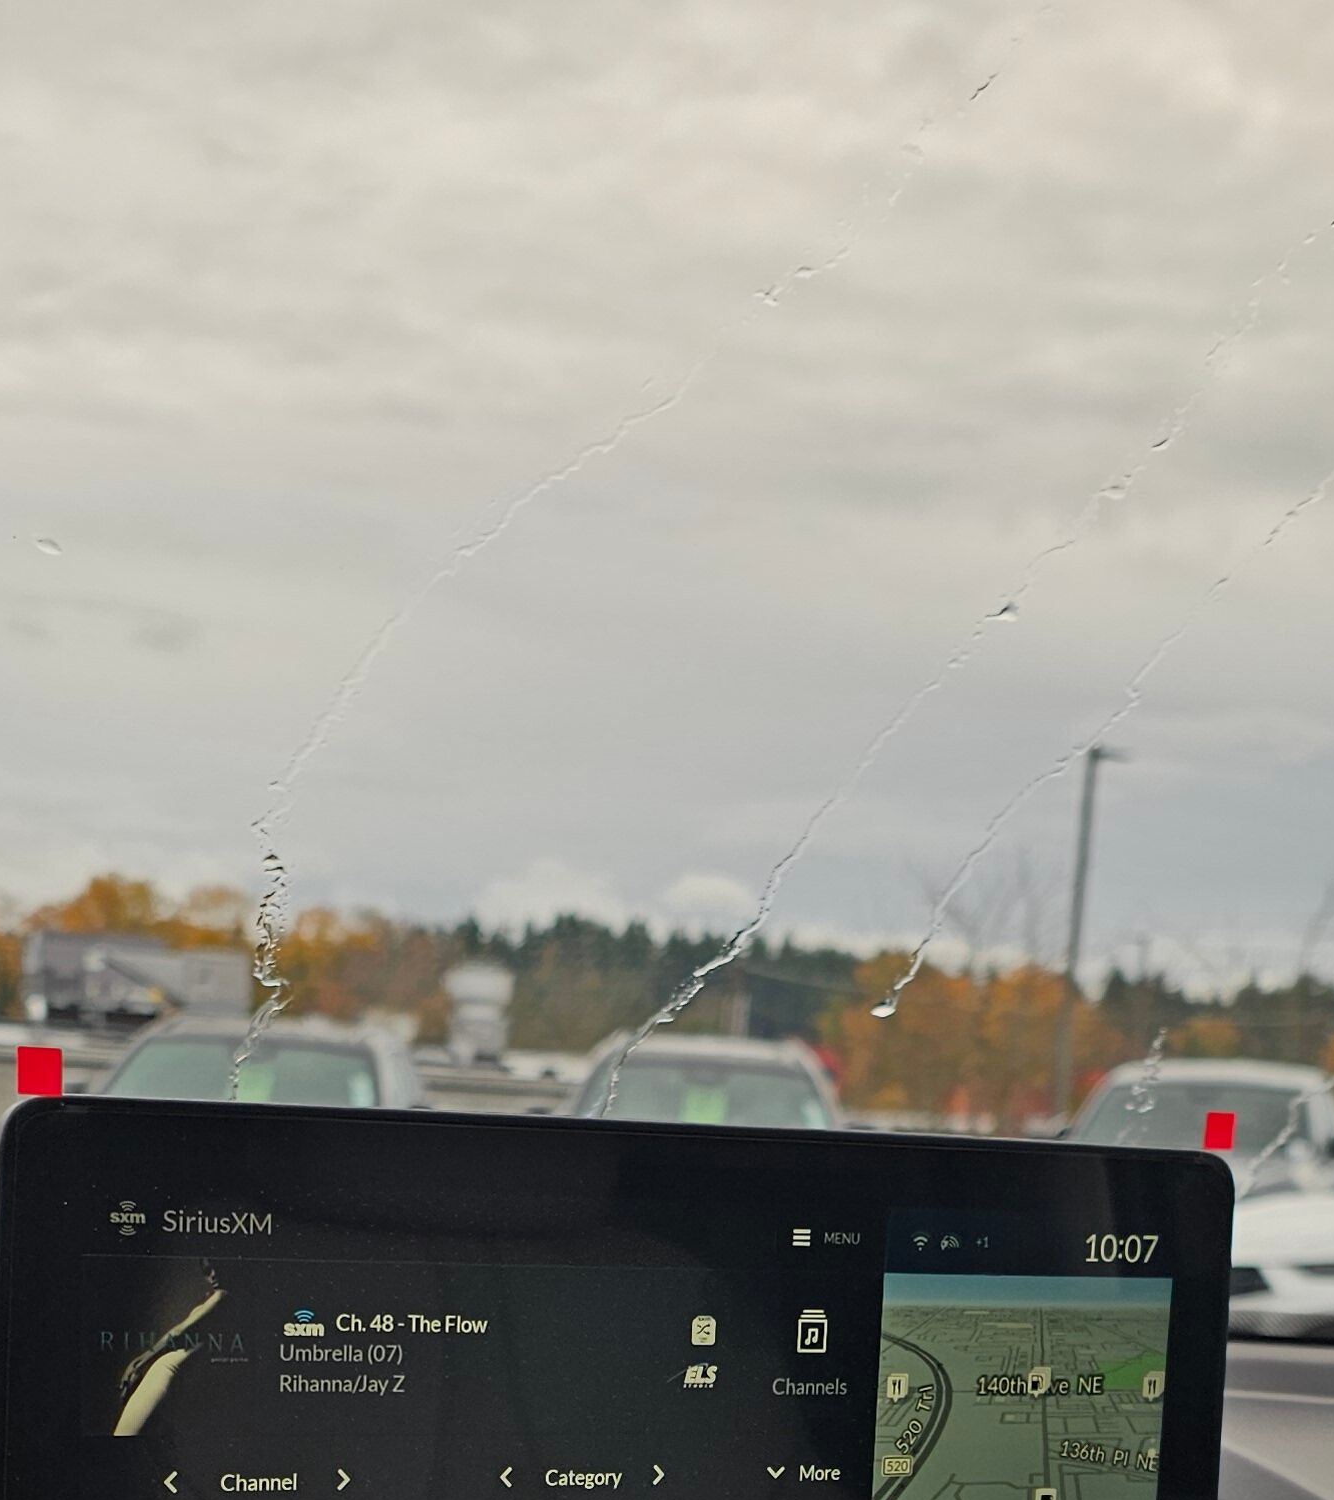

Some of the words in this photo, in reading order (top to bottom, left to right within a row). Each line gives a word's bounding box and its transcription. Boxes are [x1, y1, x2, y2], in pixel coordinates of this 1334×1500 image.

[162, 1210, 272, 1235] SiriusXM
[824, 1232, 861, 1245] MENU
[1085, 1234, 1159, 1263] 10:07
[336, 1313, 366, 1332] Ch.
[369, 1314, 394, 1332] 48
[408, 1314, 441, 1333] The
[444, 1315, 488, 1334] Flow
[279, 1343, 363, 1362] Umbrella
[367, 1344, 403, 1365] (07)
[684, 1365, 717, 1384] ELS
[279, 1374, 388, 1396] Rihanna/Jay
[392, 1375, 406, 1393] Z
[772, 1378, 847, 1396] Channels
[977, 1376, 1027, 1396] 140th
[1078, 1376, 1104, 1395] NE
[895, 1420, 923, 1455] 520
[916, 1384, 934, 1413] Trl
[1061, 1440, 1105, 1463] 136th
[799, 1464, 841, 1481] More
[886, 1460, 909, 1473] 520
[220, 1473, 297, 1492] Channel
[545, 1469, 622, 1489] Category
